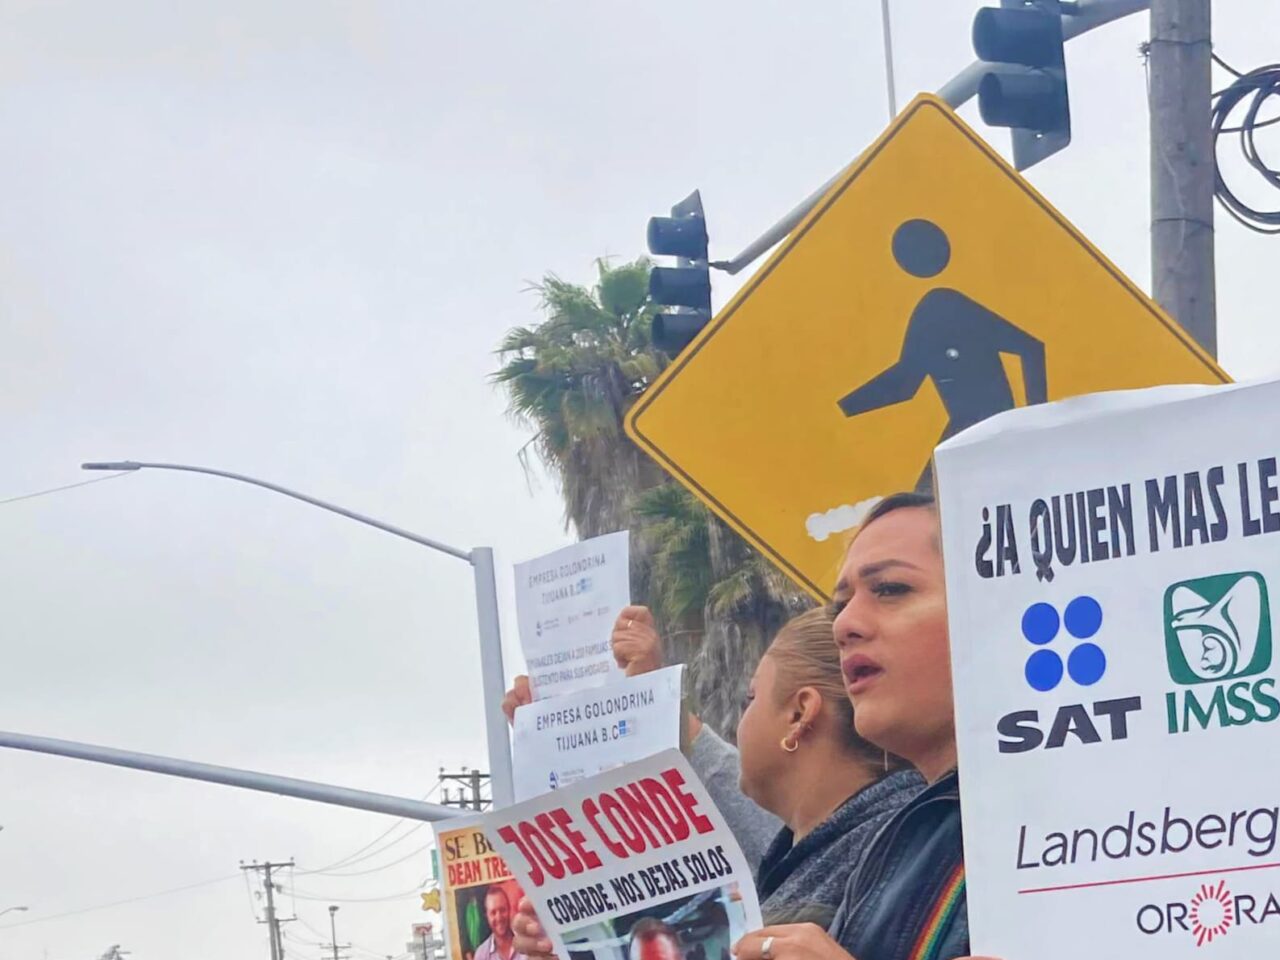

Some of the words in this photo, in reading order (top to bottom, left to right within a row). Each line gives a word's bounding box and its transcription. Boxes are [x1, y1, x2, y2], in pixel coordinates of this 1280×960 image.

[975, 503, 1021, 579] ¿A
[1028, 483, 1137, 583] QUIEN
[1144, 465, 1229, 553] MAS
[536, 706, 582, 731] EMPRESA
[584, 689, 655, 719] GOLONDRINA
[996, 696, 1141, 754] SAT
[1165, 678, 1280, 734] IMSS
[556, 729, 599, 752] TIJUANA
[445, 835, 469, 861] SE
[497, 807, 603, 887] JOSE
[581, 768, 715, 859] CONDE
[1016, 806, 1280, 870] Landsberg
[447, 858, 482, 886] DEAN
[546, 882, 618, 925] COBARDE,
[609, 871, 644, 907] NOS
[638, 859, 689, 898] DEJAS
[683, 845, 734, 885] SOLOS
